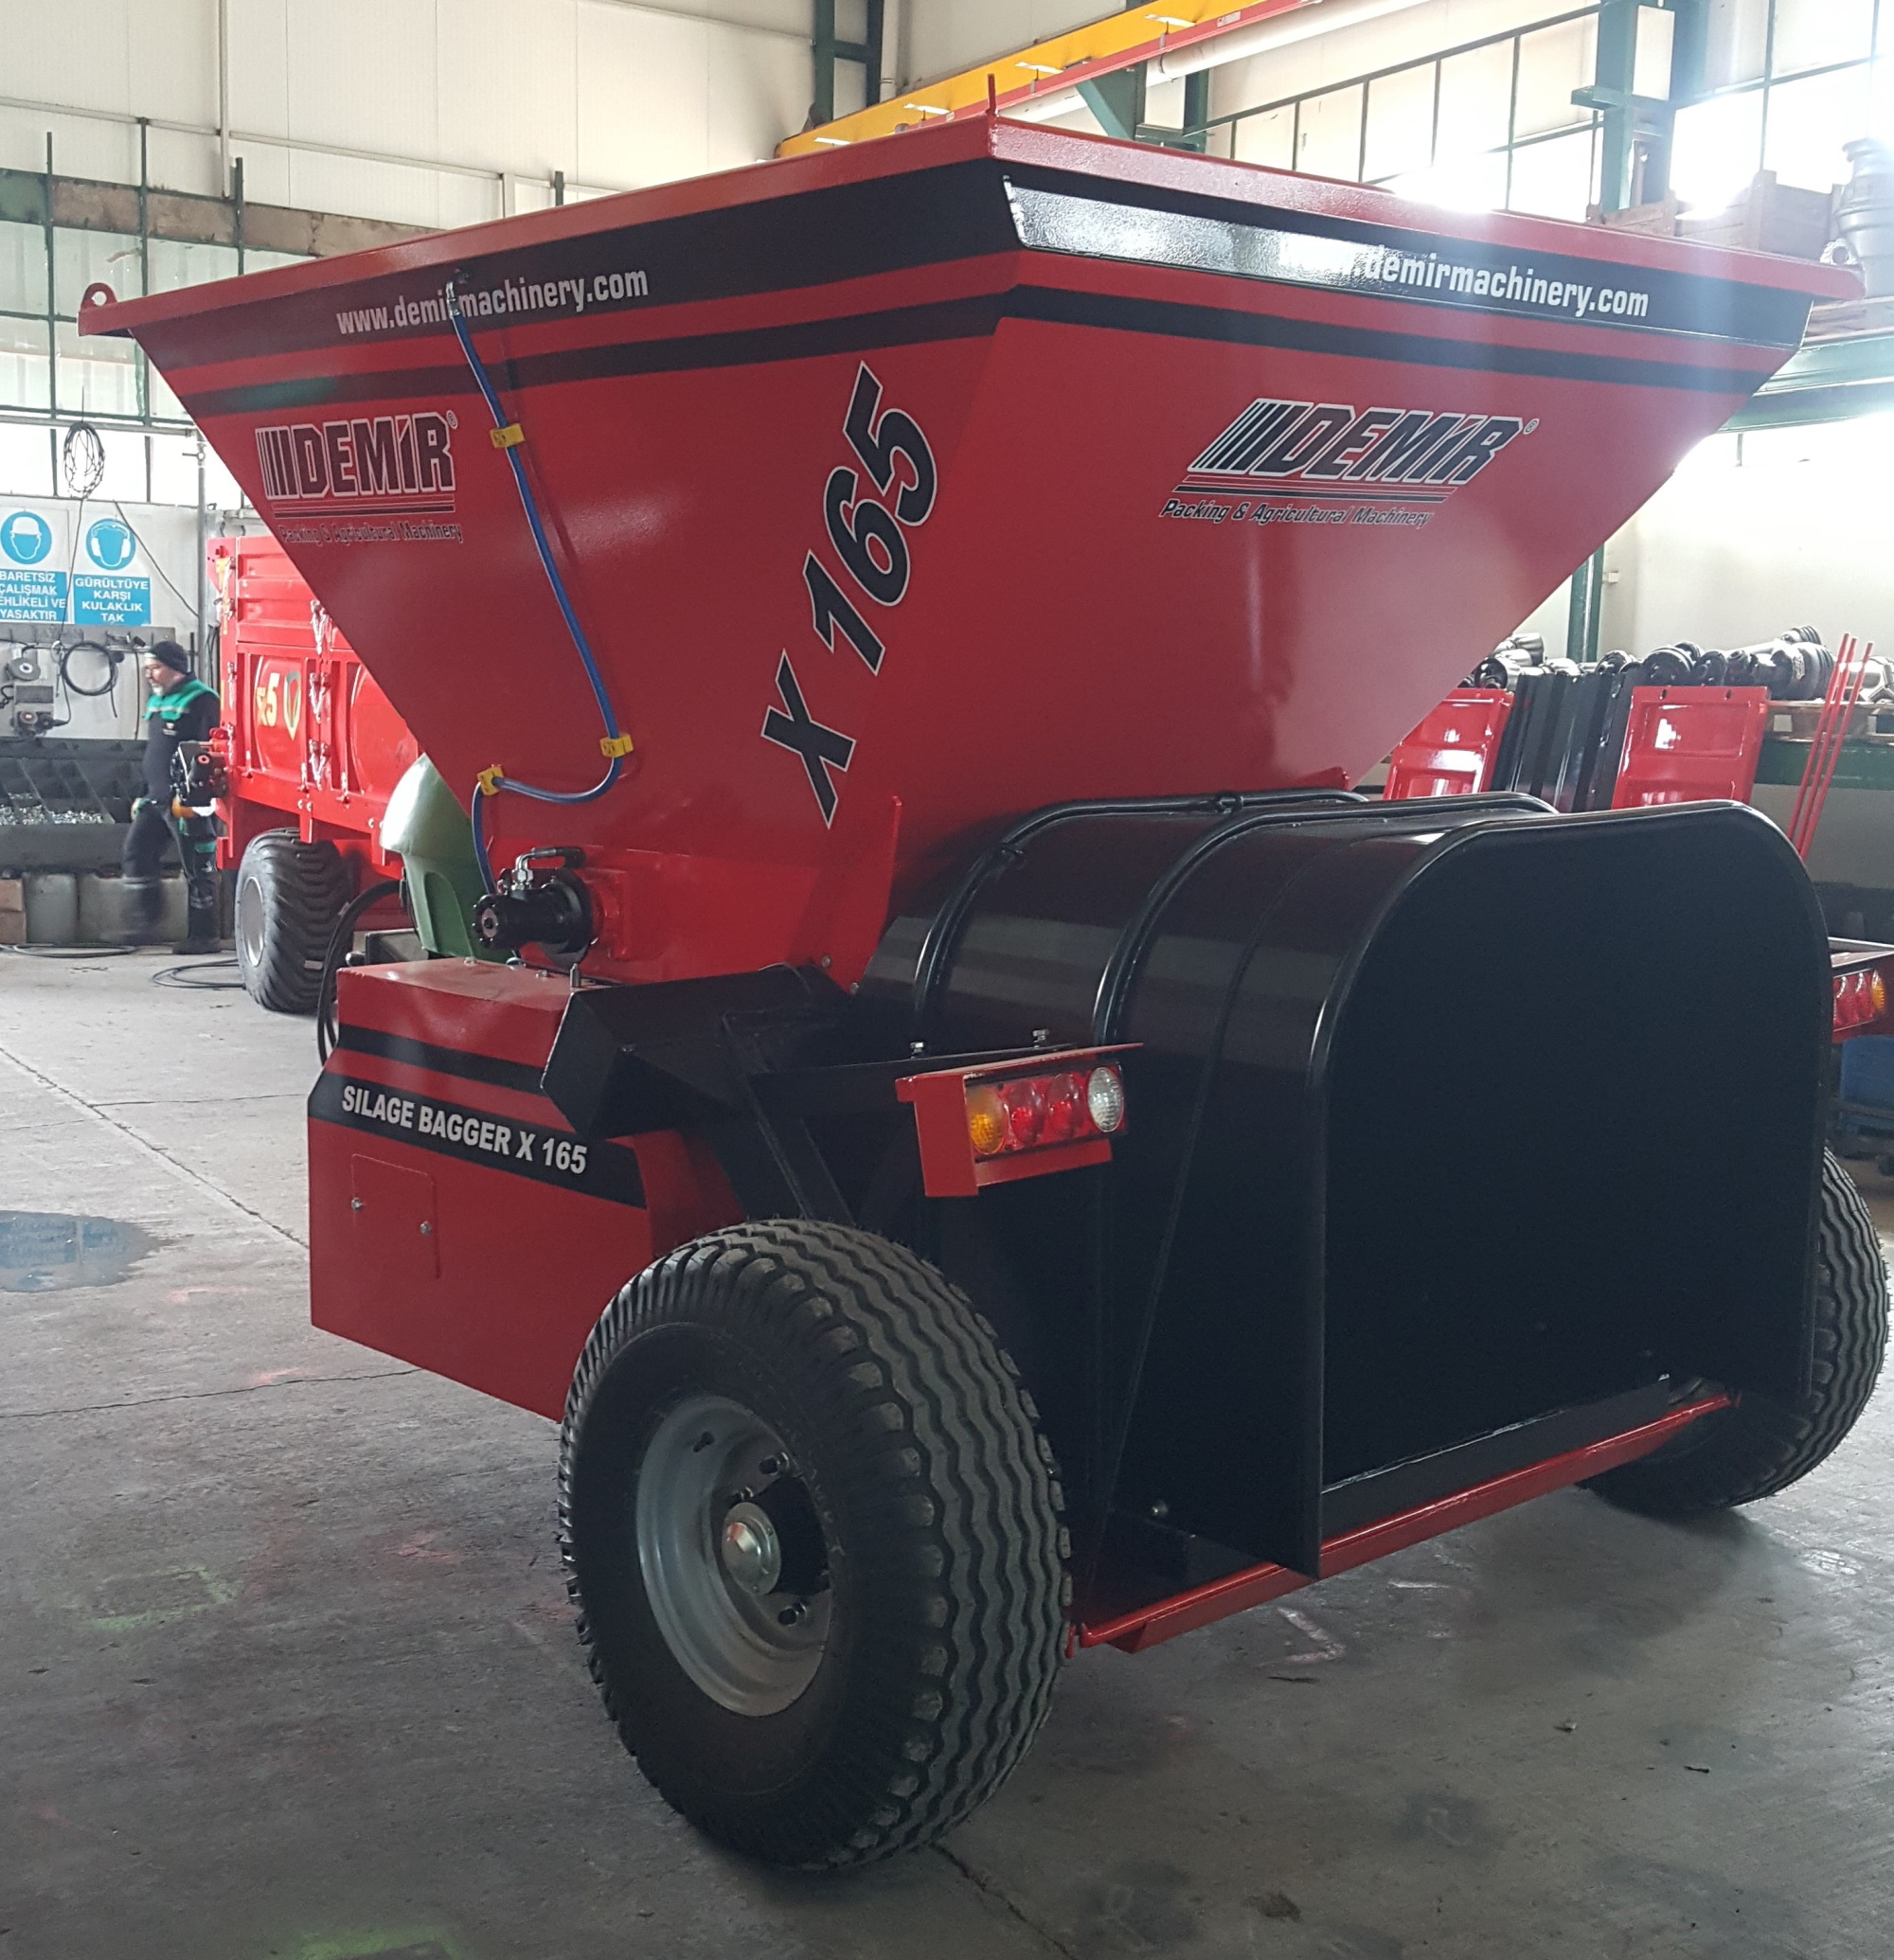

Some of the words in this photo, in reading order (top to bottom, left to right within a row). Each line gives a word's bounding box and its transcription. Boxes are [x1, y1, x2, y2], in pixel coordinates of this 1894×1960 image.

[1297, 242, 1650, 318] .demirmachinery.com
[335, 269, 649, 334] www.demimachinery.com
[802, 360, 938, 677] 165
[1158, 498, 1230, 524] Packing
[1231, 501, 1251, 521] &
[1250, 502, 1349, 526] Agricultural
[1349, 504, 1435, 530] Machinery
[278, 525, 323, 546] Packing
[332, 522, 401, 546] Agricultural
[401, 520, 463, 543] Machinery
[0, 583, 58, 597] ÇALIŞMAK
[75, 576, 149, 590] GÜRÜLTÜYE
[0, 595, 48, 608] EHLİKELİ
[51, 597, 66, 609] VE
[94, 590, 131, 602] KARŞI
[0, 609, 57, 621] YASAKTIR
[81, 600, 143, 613] KULAKLIK
[100, 612, 125, 623] TAK
[761, 648, 857, 829] X
[342, 1085, 415, 1129] SILAGE
[419, 1105, 512, 1155] BAGGER
[515, 1131, 536, 1162] X
[542, 1137, 588, 1174] 165
